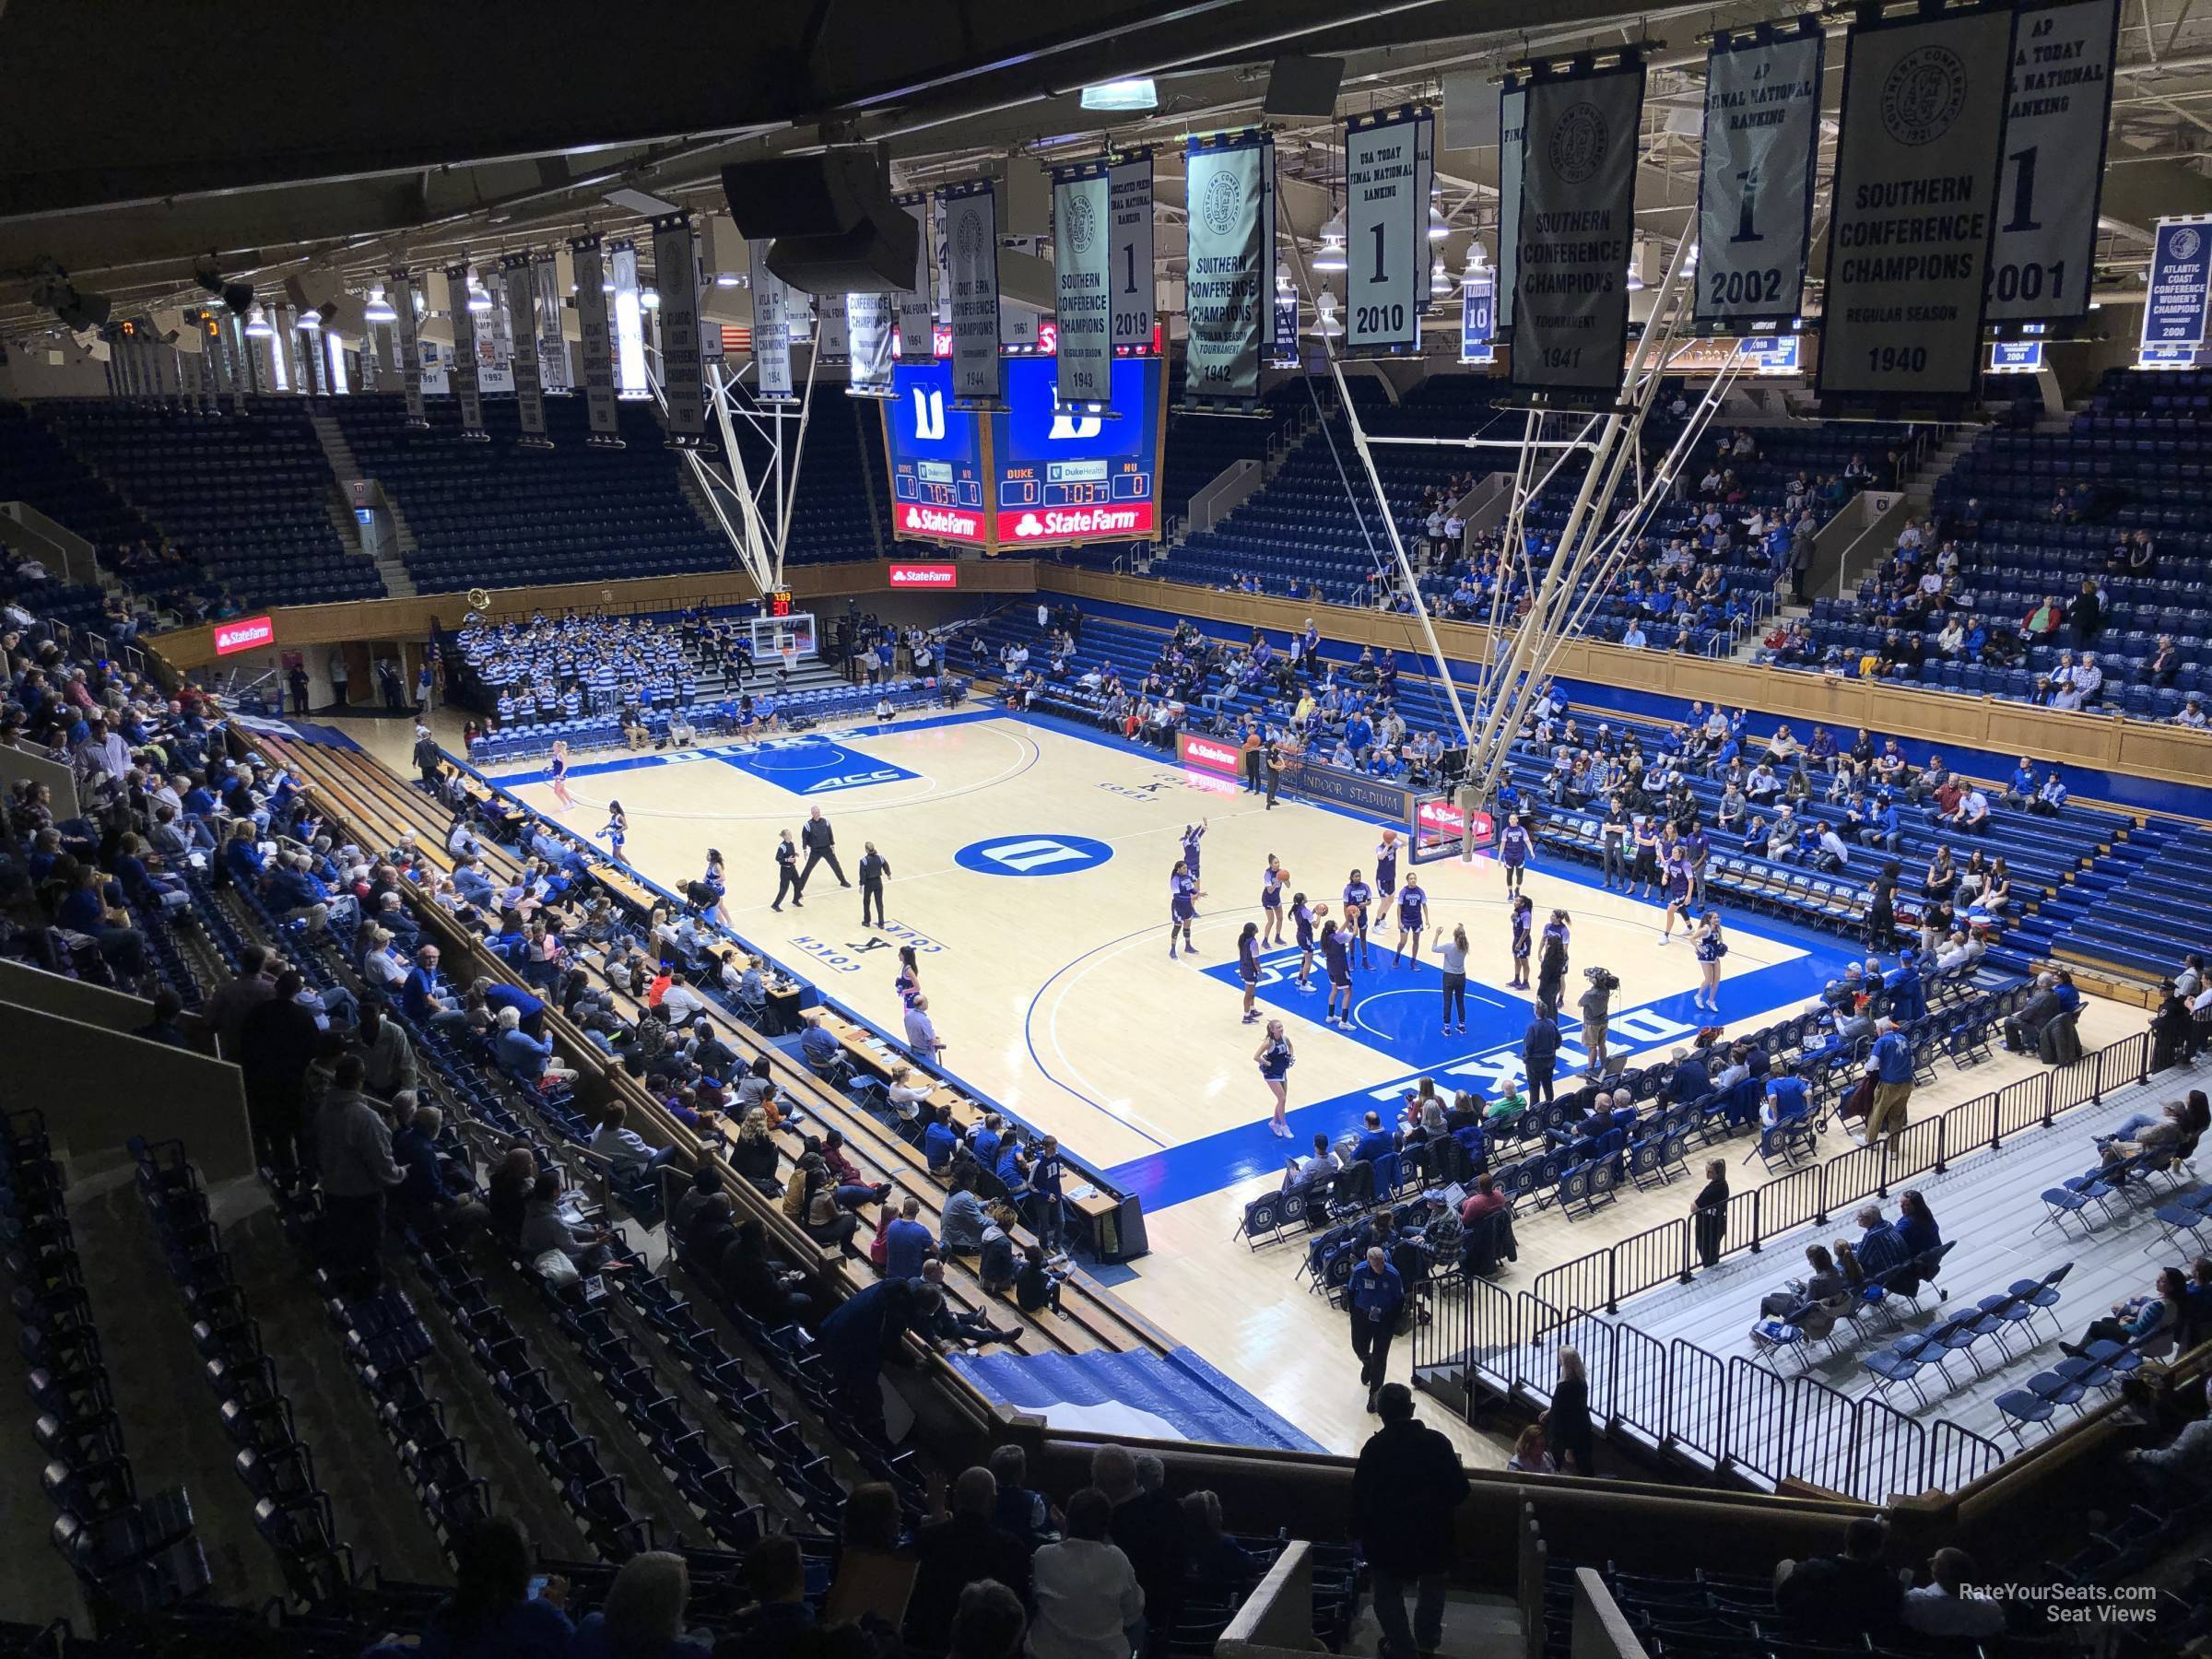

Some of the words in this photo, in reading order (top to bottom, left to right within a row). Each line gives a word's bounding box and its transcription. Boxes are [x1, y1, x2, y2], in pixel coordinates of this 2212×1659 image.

[2032, 18, 2053, 37] AP
[2033, 40, 2085, 63] TODAY
[2024, 64, 2103, 91] NATIONAL
[1712, 90, 1746, 110] FINAL
[2009, 95, 2070, 118] ANKING
[1730, 109, 1785, 130] RANKING
[1360, 152, 1374, 165] USA
[1377, 146, 1402, 162] TODAY
[1349, 169, 1371, 185] FINAL
[1373, 162, 1413, 181] NATIONAL
[1364, 184, 1396, 202] RANKING
[1855, 175, 1973, 210] SOUTHERN
[2002, 146, 2042, 232] 1
[1111, 200, 1124, 210] INAL
[1125, 194, 1150, 207] NATIONAL
[1730, 166, 1764, 242] 1
[1536, 210, 1610, 232] SOUTHERN
[1839, 214, 1984, 248] CONFERENCE
[1370, 221, 1389, 284] 1
[1524, 240, 1622, 264] CONFERENCE
[1124, 243, 1138, 294] 1
[1196, 256, 1246, 274] SOUTHERN
[1842, 253, 1973, 284] CHAMPIONS
[2163, 264, 2200, 274] ATLANTIC
[1062, 272, 1100, 289] SOUTHERN
[1525, 272, 1613, 294] CHAMPIONS
[1711, 268, 1782, 305] 2002
[2168, 275, 2194, 283] COAST
[1191, 280, 1255, 299] CONFERENCE
[2154, 284, 2206, 294] CONFERENCE
[953, 300, 995, 317] CONFERENCE
[1059, 295, 1106, 312] CONFERENCE
[2159, 295, 2197, 303] WOMEN'S
[1192, 304, 1252, 323] CHAMPIONS
[1847, 307, 1902, 323] REGULAR
[1907, 305, 1958, 322] SEASON
[2153, 304, 2201, 314] CHAMPIONS
[851, 315, 888, 329] CHAMPIONS
[1061, 318, 1104, 333] CHAMPIONS
[1115, 312, 1147, 335] 2019
[1357, 304, 1404, 334] 2010
[1468, 309, 1487, 329] 10
[955, 323, 994, 337] CHAMPIONS
[1224, 331, 1247, 342] SEASON
[1064, 348, 1084, 358] REGULAR
[1199, 344, 1240, 355] TOURNAMENT
[1542, 347, 1583, 368] 1941
[1868, 347, 1926, 372] 1940
[484, 373, 503, 382] 1992
[967, 372, 984, 386] 1944
[1074, 372, 1093, 387] 1943
[1205, 365, 1230, 382] 1942
[1007, 468, 1033, 479] DUKE
[1065, 467, 1104, 477] DukeHealth
[1024, 482, 1033, 502] 0
[1060, 484, 1093, 503] 7:03
[1134, 476, 1143, 494] 0
[773, 601, 789, 617] 30
[656, 729, 867, 764] DUKE
[803, 769, 900, 793] ACC
[1137, 782, 1172, 793] K
[1099, 782, 1159, 803] COURT
[1303, 773, 1343, 796] INDOOR
[1349, 787, 1399, 811] STADIUM
[793, 936, 861, 971] COACH
[845, 936, 893, 953] K
